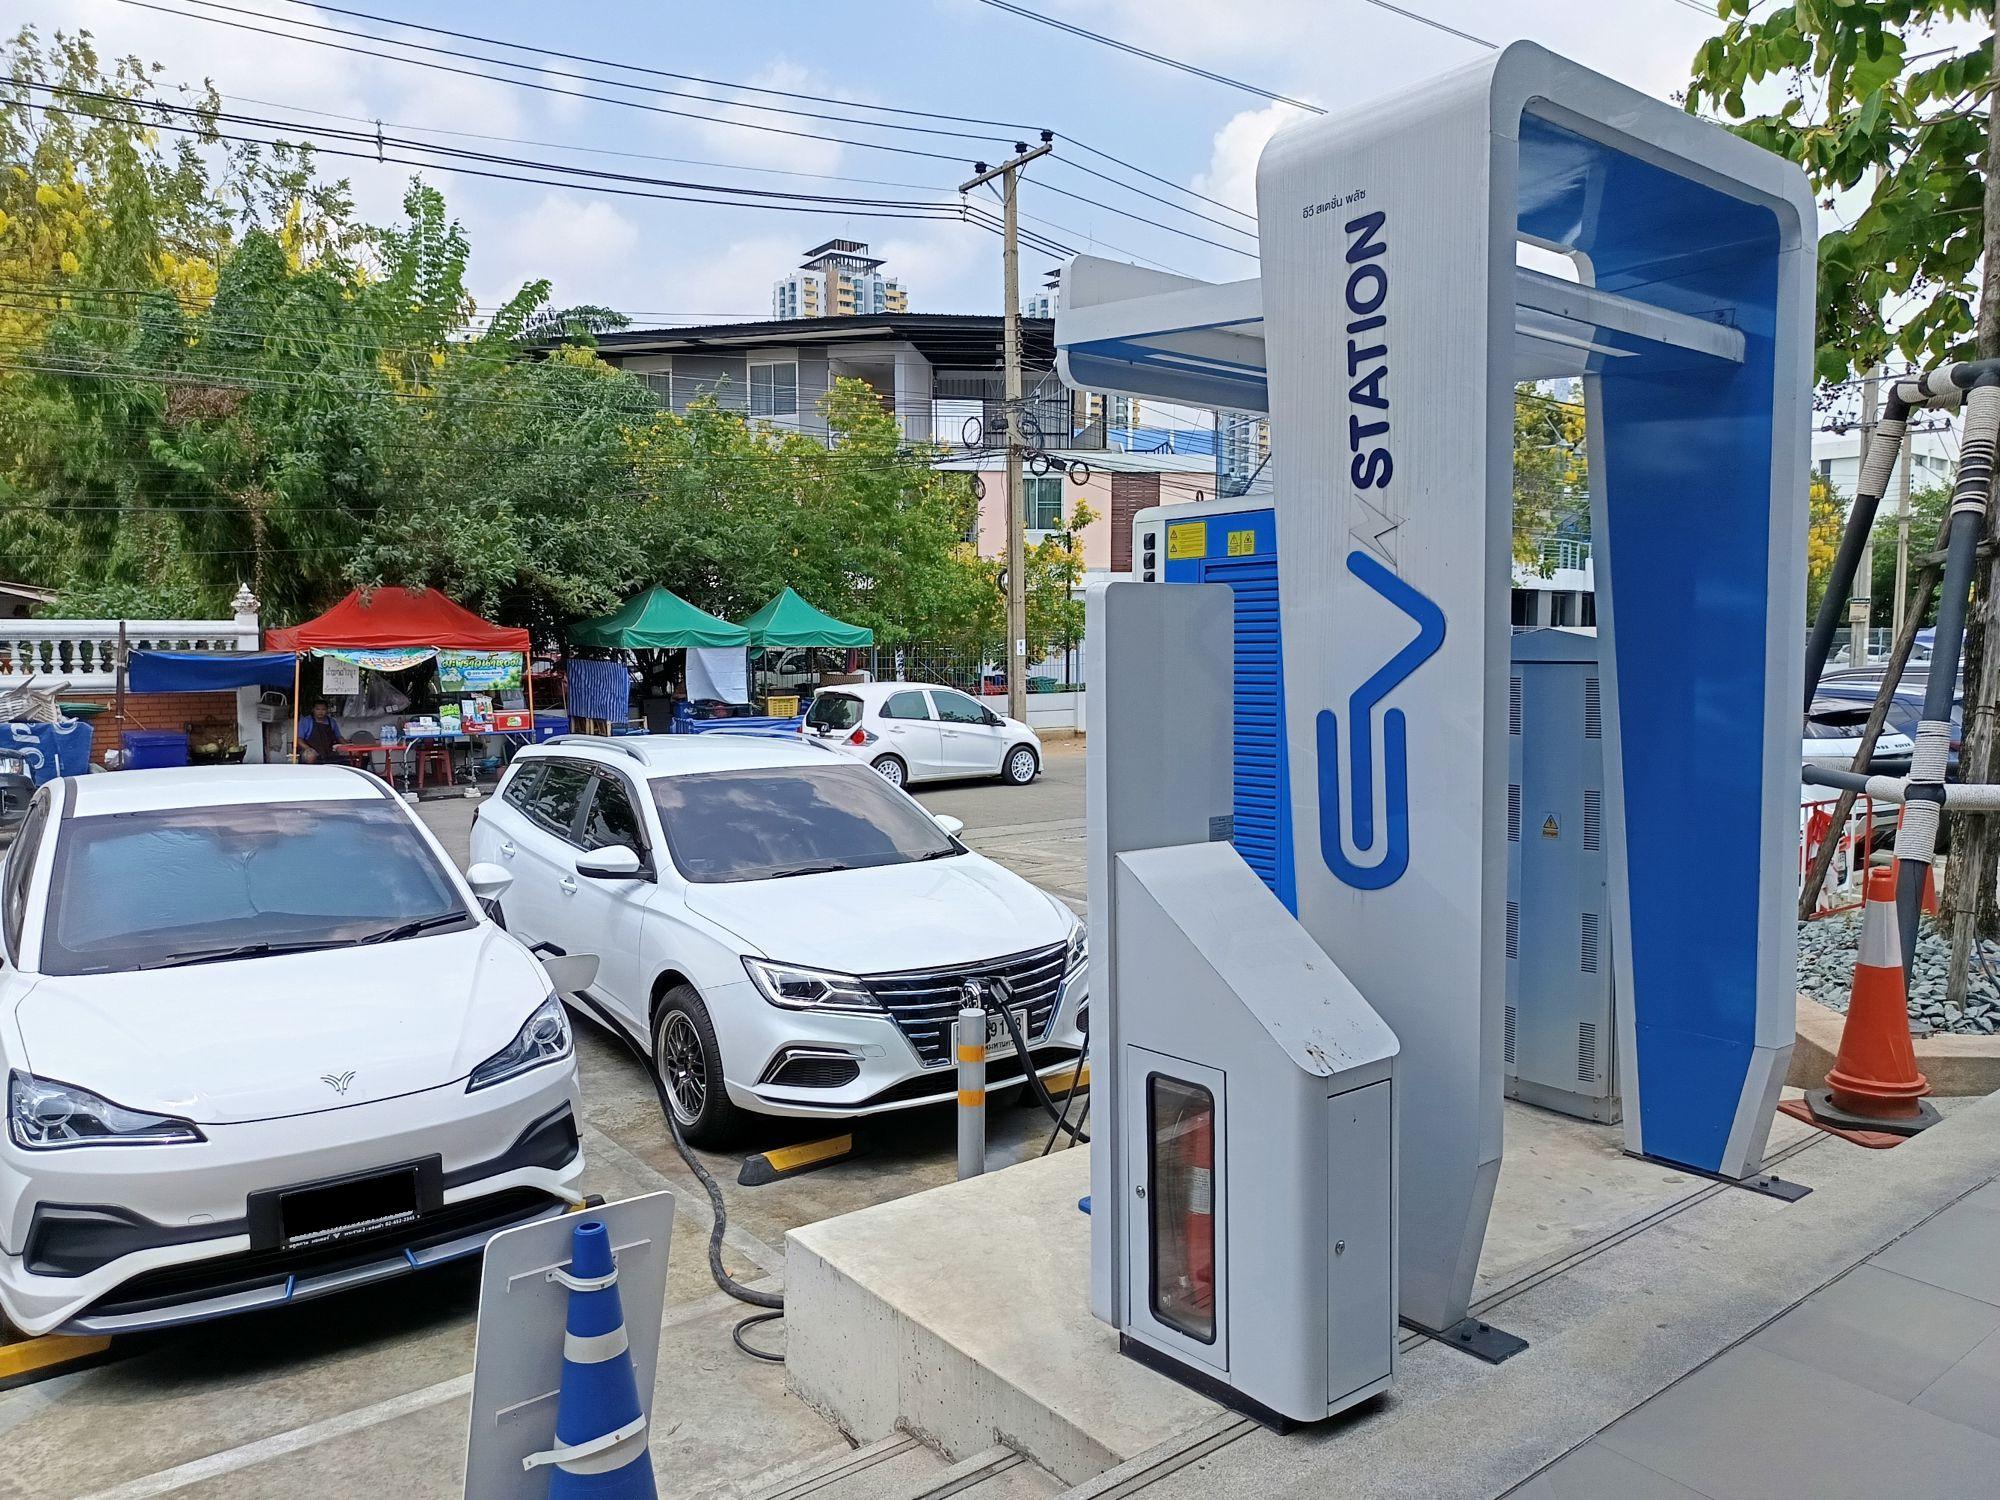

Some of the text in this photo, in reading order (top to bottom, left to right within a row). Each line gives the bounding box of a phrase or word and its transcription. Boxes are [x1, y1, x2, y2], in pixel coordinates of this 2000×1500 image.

[1302, 204, 1314, 219] อีวี
[1316, 194, 1343, 214] สเตชั่น
[1315, 210, 1446, 890] EV STATION
[990, 1016, 1022, 1037] 918
